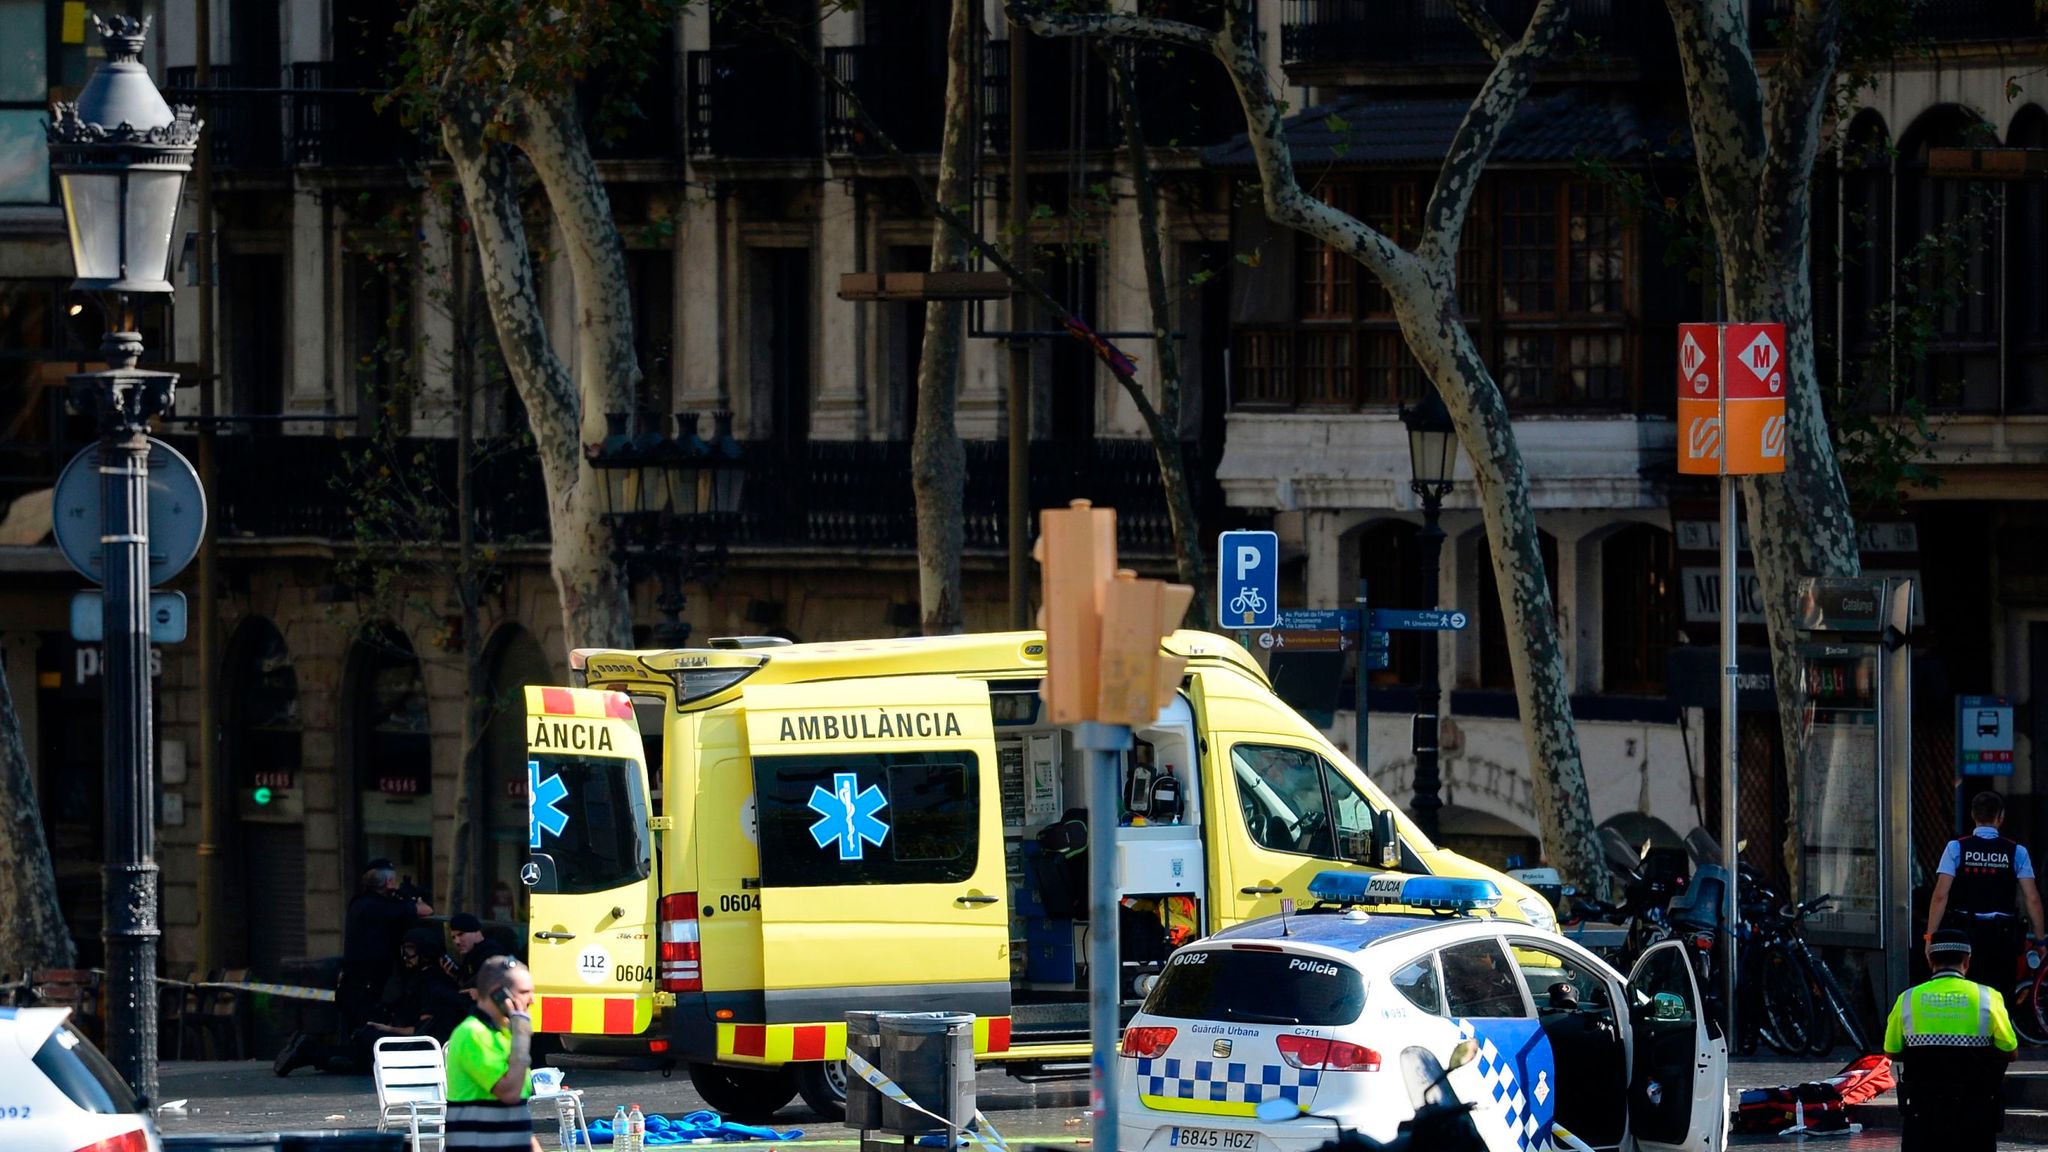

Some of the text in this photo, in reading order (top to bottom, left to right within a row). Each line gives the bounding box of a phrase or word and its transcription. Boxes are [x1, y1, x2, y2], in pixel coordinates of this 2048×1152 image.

[1684, 345, 1695, 368] M
[1753, 345, 1770, 368] M
[1237, 546, 1261, 580] P
[1842, 598, 1873, 613] Catalunya
[1737, 673, 1771, 690] OURIST
[780, 707, 961, 741] AMBULÀNCIA
[1965, 851, 2009, 863] POLICIA
[1369, 880, 1401, 892] POLICIA
[720, 894, 761, 912] 0604
[583, 955, 605, 968] 112
[1183, 953, 1208, 965] 092
[1289, 958, 1338, 976] Policia
[616, 965, 654, 982] 0604
[1191, 1024, 1260, 1037] Guàrdia Urbana
[1294, 1027, 1320, 1037] C-711
[1181, 1130, 1254, 1149] 6845 HGZ
